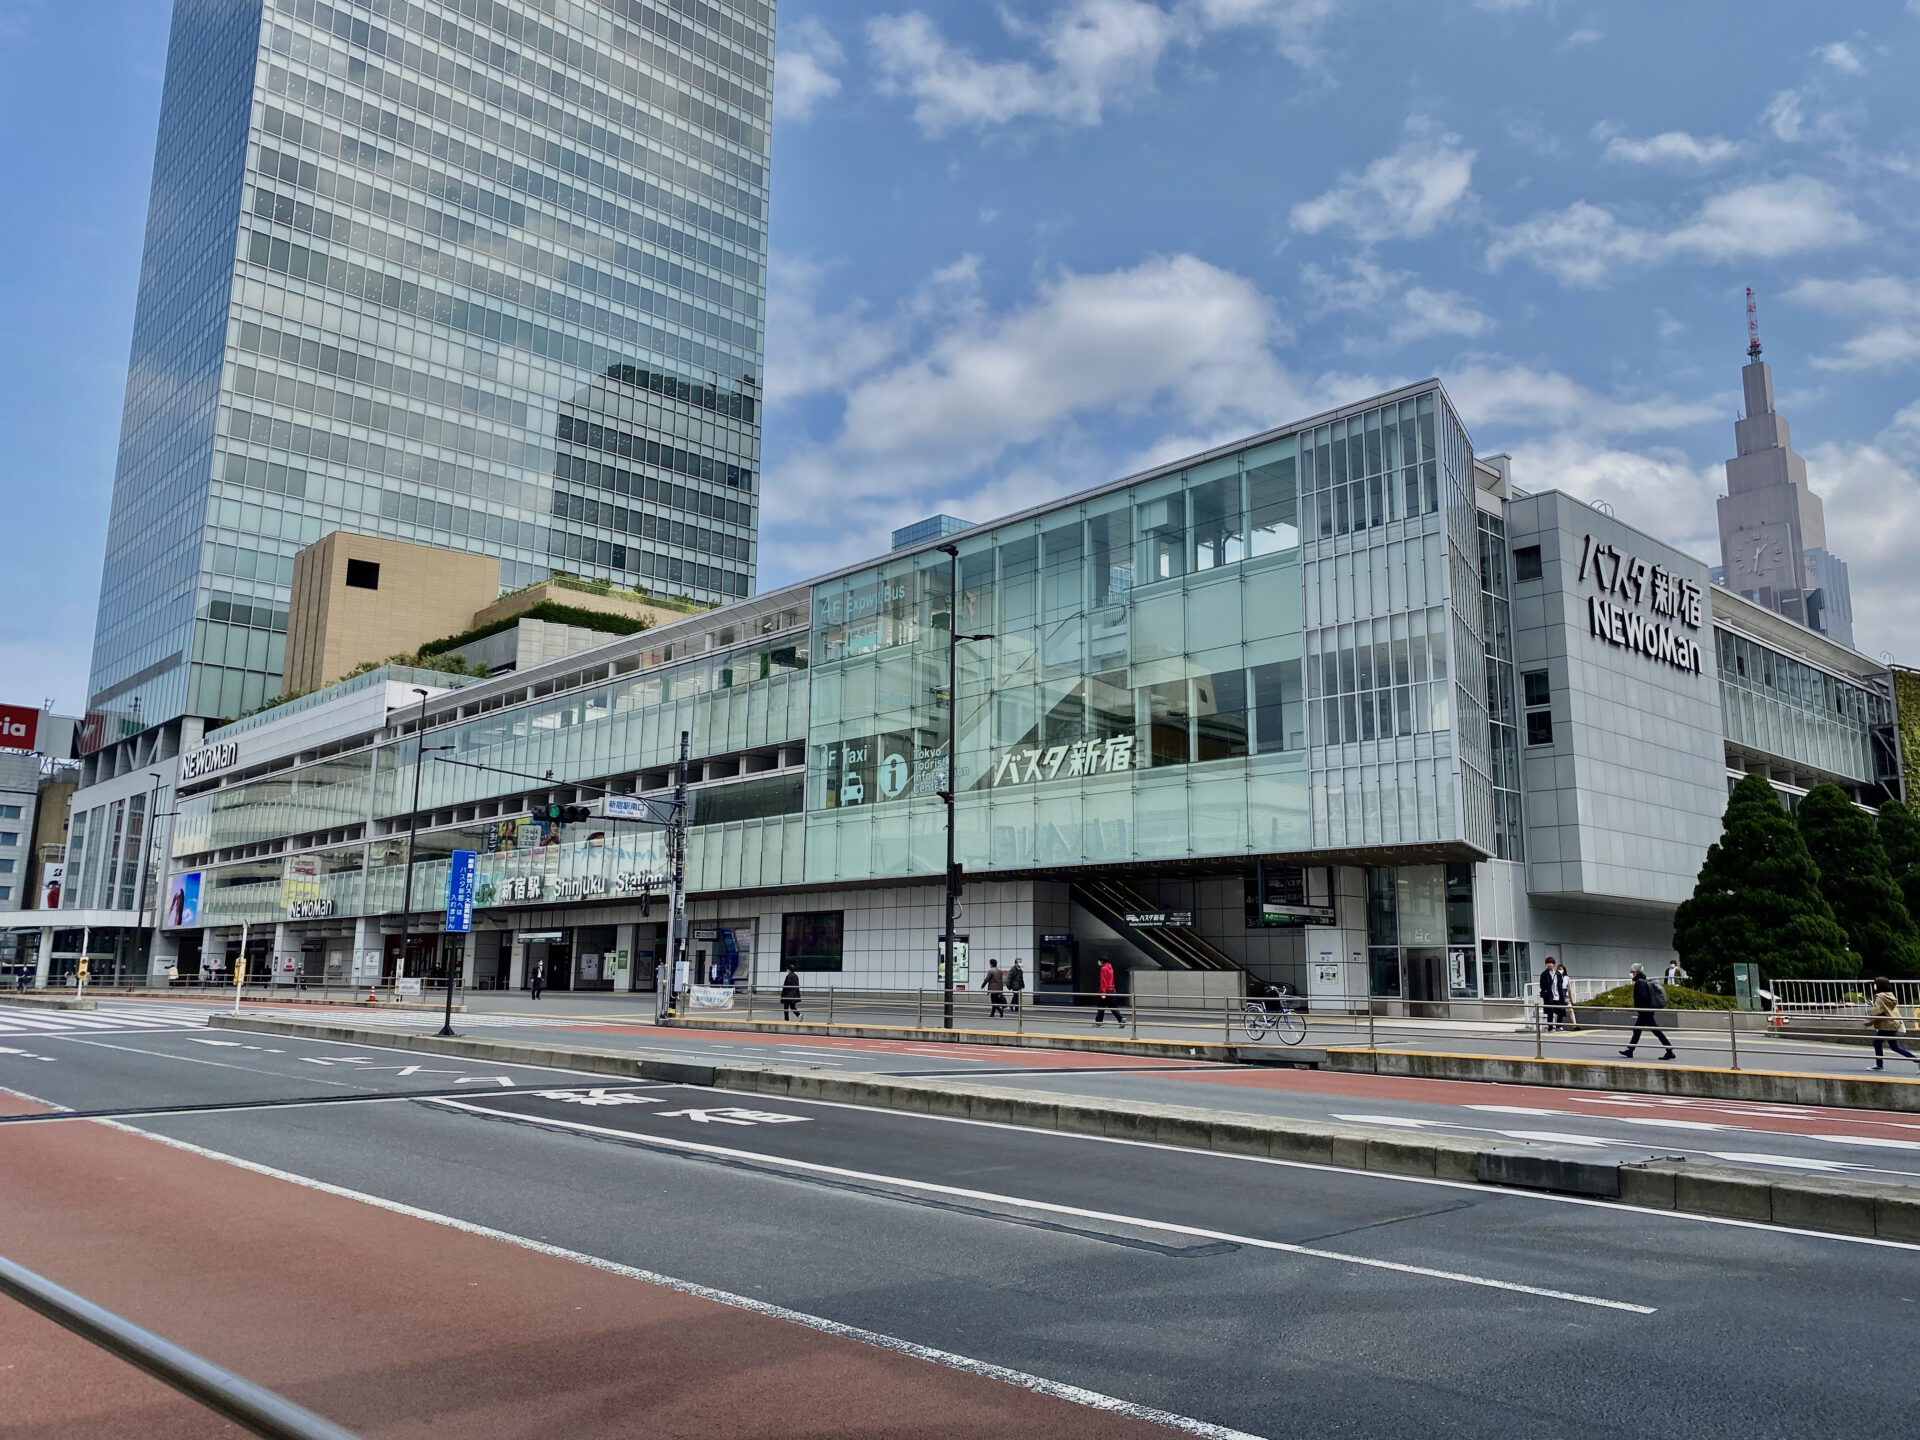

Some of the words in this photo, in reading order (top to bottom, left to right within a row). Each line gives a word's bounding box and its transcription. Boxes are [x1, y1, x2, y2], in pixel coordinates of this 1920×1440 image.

[1580, 533, 1703, 629] バスタ新宿
[884, 585, 905, 602] Bus
[842, 744, 868, 765] Taxi
[914, 748, 941, 760] Tokyo
[914, 756, 947, 771] Tourist
[993, 733, 1136, 788] バスタ新宿
[609, 800, 645, 811] 新宿駅南口
[501, 875, 541, 901] 新宿駅
[554, 874, 605, 900] Shinjuku
[616, 870, 664, 892] Station
[448, 894, 457, 929] 入れません
